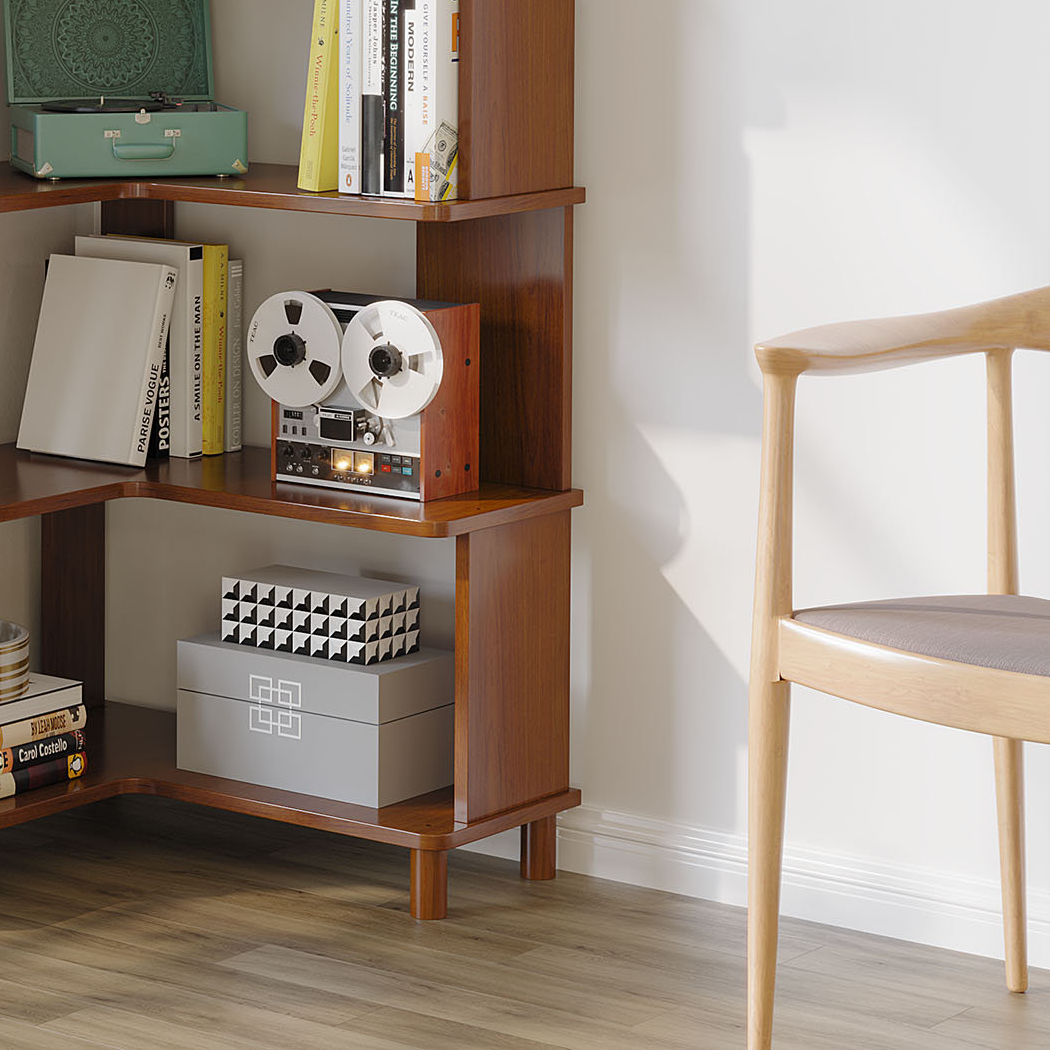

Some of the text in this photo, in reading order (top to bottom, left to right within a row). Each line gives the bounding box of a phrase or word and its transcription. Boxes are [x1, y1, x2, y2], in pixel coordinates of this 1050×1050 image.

[319, 0, 327, 28] MILNE
[389, 0, 398, 14] IN
[389, 17, 398, 40] THE
[345, 39, 353, 65] Years
[407, 21, 415, 92] MODERN
[345, 68, 353, 80] of
[389, 43, 398, 111] BEGINNING
[309, 55, 323, 137] Winnie-the-Pooh
[345, 83, 353, 124] Solitude
[249, 320, 259, 342] TEAC
[194, 354, 201, 371] ON
[137, 363, 159, 453] PARISE VOGUE
[158, 376, 170, 450] POSTERS
[194, 413, 201, 421] A
[30, 721, 38, 737] BY
[38, 717, 50, 734] LEAH
[50, 714, 66, 731] MOOSE
[18, 745, 38, 763] Carol
[39, 738, 68, 758] Costello
